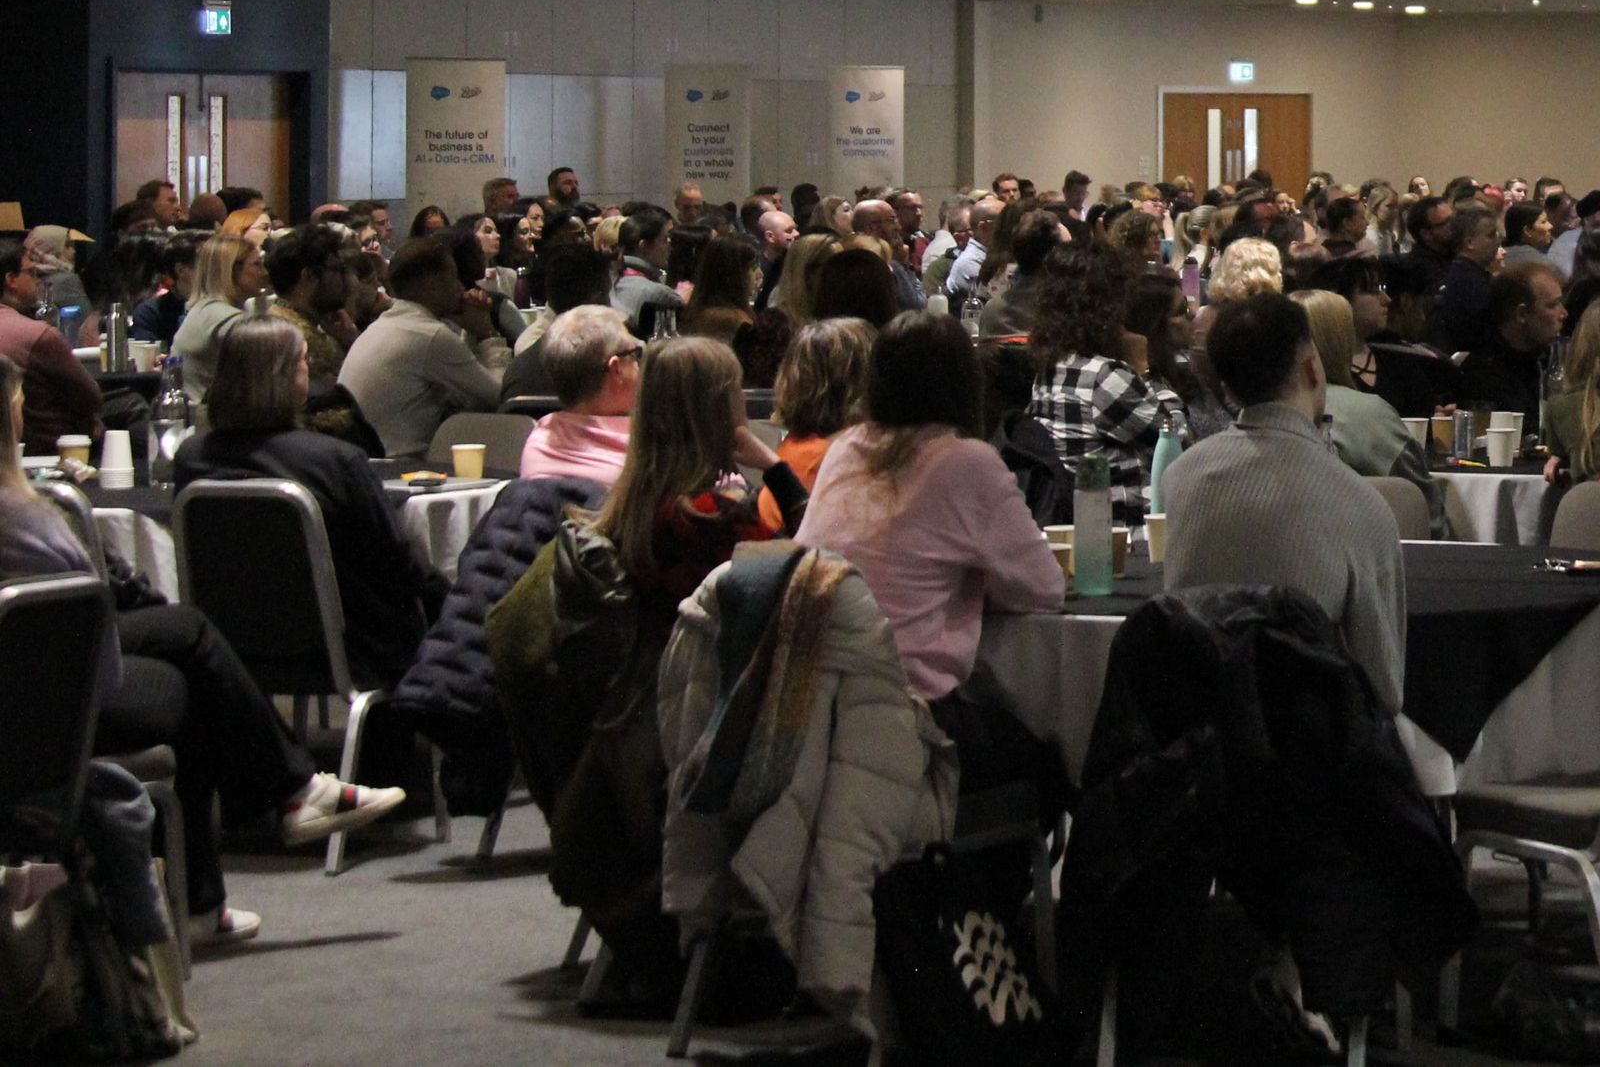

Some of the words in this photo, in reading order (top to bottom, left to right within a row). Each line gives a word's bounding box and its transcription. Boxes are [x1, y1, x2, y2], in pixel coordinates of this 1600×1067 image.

[687, 123, 730, 133] Connect
[849, 126, 864, 135] We
[866, 127, 881, 135] are
[424, 129, 442, 139] The
[445, 129, 475, 140] future
[477, 129, 489, 139] of
[691, 135, 701, 144] to
[703, 136, 726, 146] your
[835, 137, 850, 146] the
[852, 137, 896, 146] customer
[428, 142, 473, 152] business
[476, 142, 484, 151] is
[414, 154, 426, 164] AI
[435, 154, 460, 164] Data
[683, 159, 692, 168] in
[695, 160, 701, 168] a
[703, 159, 735, 168] whole
[686, 171, 706, 179] new
